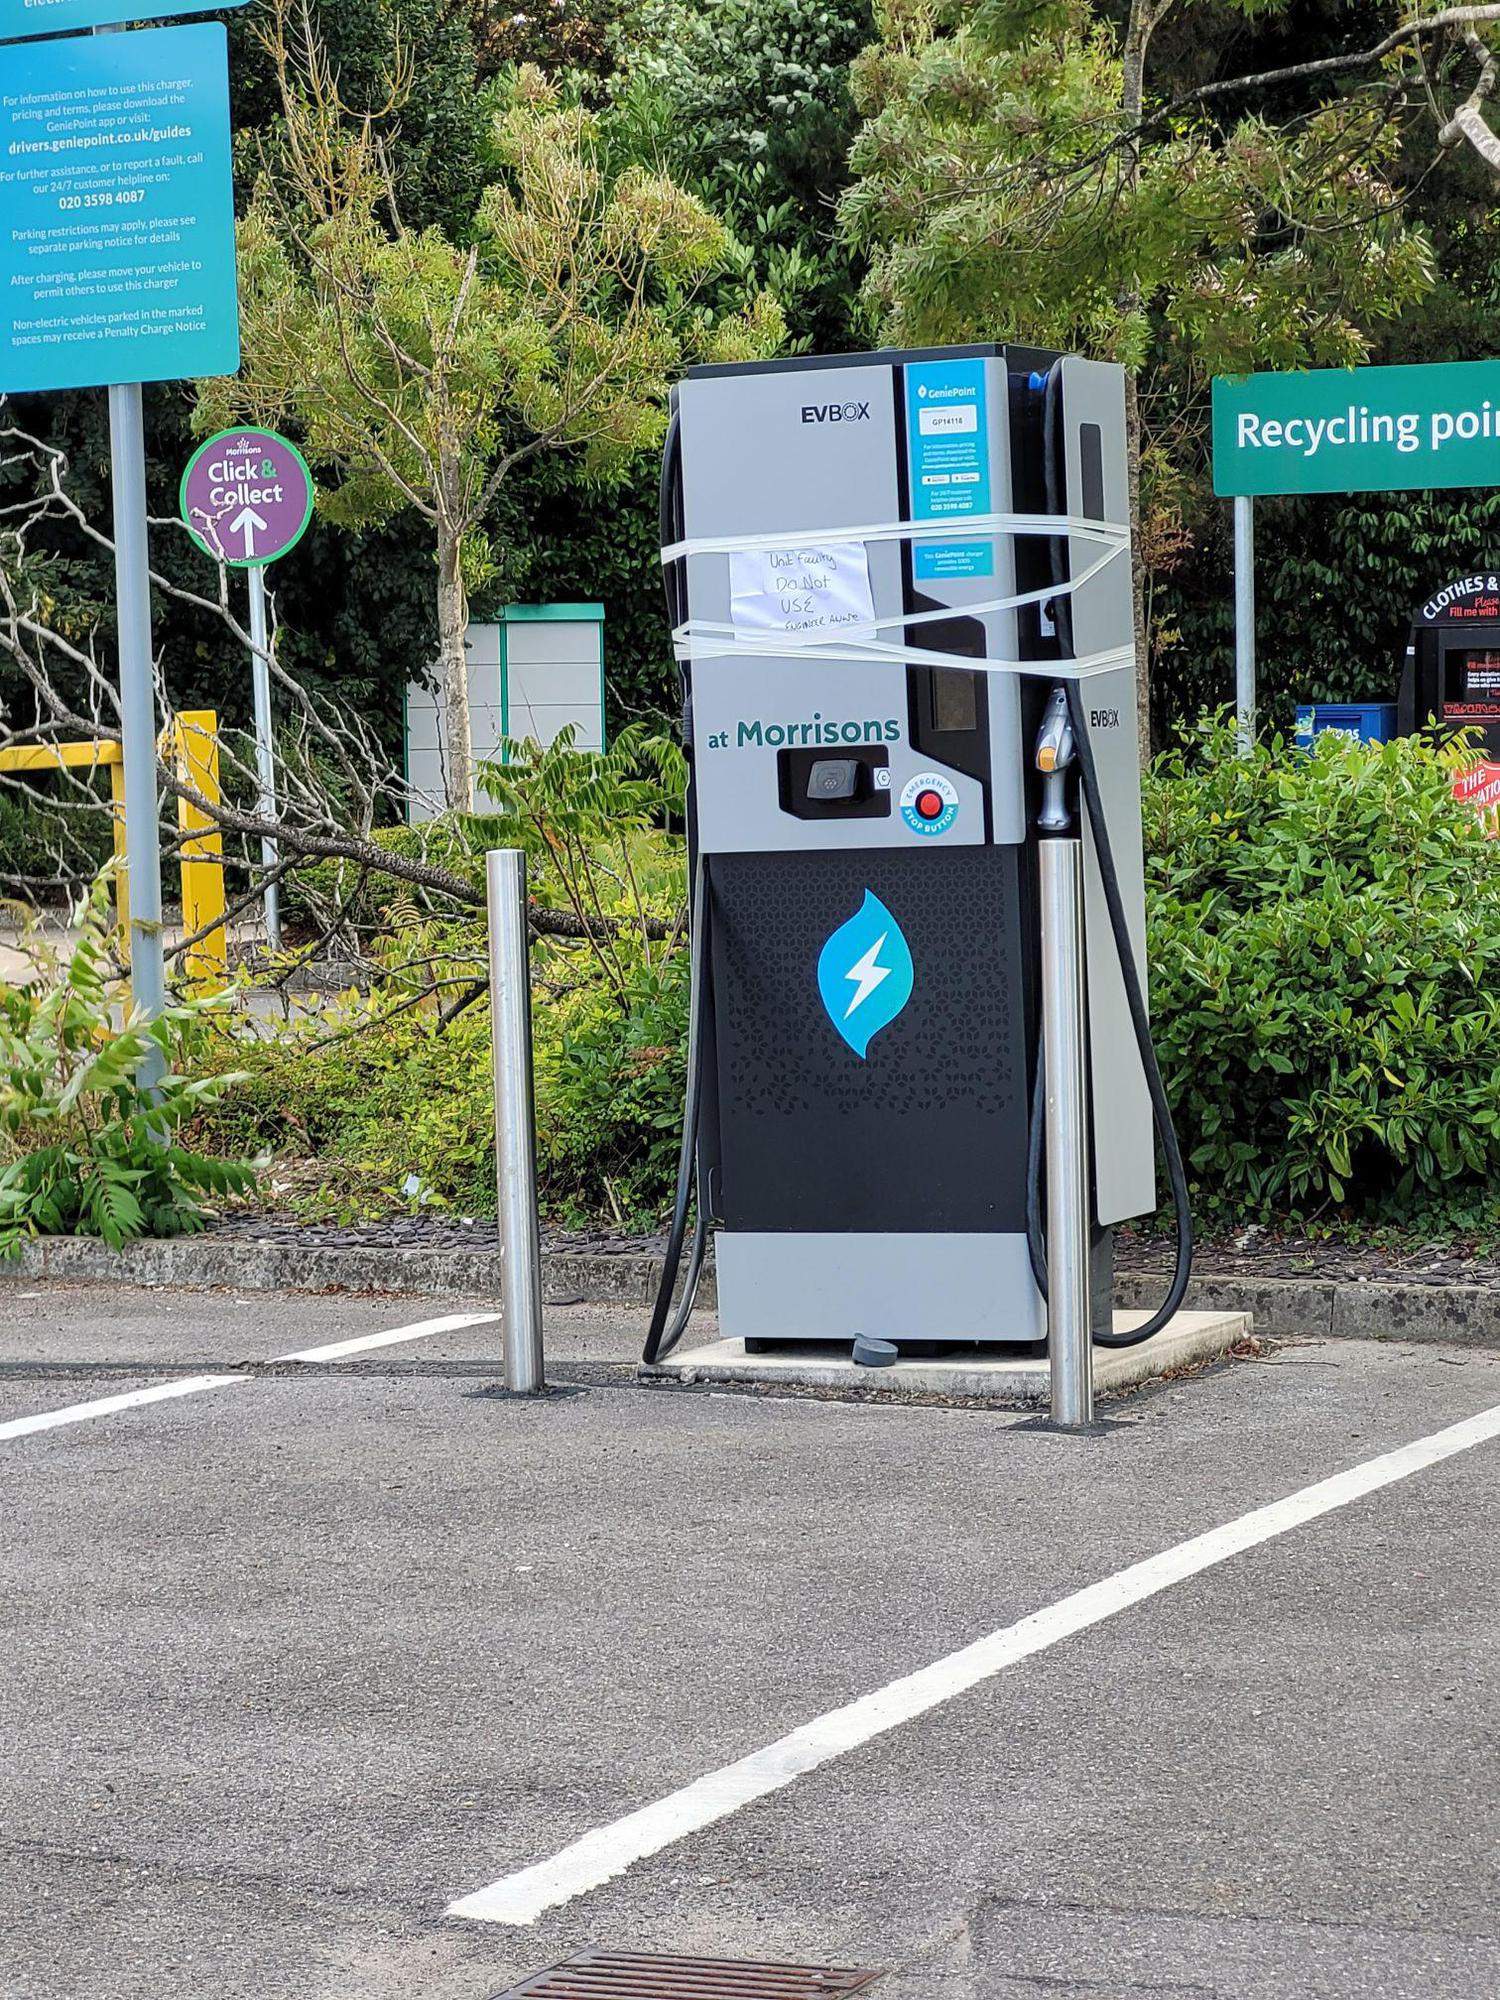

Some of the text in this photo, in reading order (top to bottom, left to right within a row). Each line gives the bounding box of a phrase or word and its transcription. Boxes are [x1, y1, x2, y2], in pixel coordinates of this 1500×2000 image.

[3, 95, 18, 107] For
[20, 91, 72, 105] information
[74, 91, 85, 99] on
[87, 88, 107, 97] how
[109, 87, 118, 95] to
[120, 85, 136, 94] use
[138, 82, 154, 92] this
[12, 111, 43, 123] pricing
[45, 107, 61, 117] and
[93, 102, 121, 114] please
[124, 98, 168, 110] download
[170, 94, 185, 104] the
[47, 119, 96, 132] GeniePoint
[99, 118, 115, 129] app
[117, 116, 126, 125] or
[9, 126, 191, 155] drivers.geniepoint.co.uk/guides
[0, 172, 15, 182] For
[17, 168, 49, 181] further
[101, 163, 111, 172] or
[112, 160, 121, 171] to
[124, 158, 153, 171] report
[155, 159, 160, 167] a
[187, 153, 203, 164] call
[33, 184, 49, 194] our
[51, 181, 72, 193] 24/7
[74, 179, 115, 190] customer
[118, 174, 154, 187] helpline
[59, 190, 145, 209] 020 3598 4087
[12, 228, 46, 241] Parking
[48, 224, 99, 237] restrictions
[101, 223, 120, 233] may
[150, 217, 178, 229] please
[180, 216, 196, 225] see
[28, 232, 180, 255] separate parking notice for details
[10, 274, 34, 285] After
[78, 270, 106, 282] please
[108, 267, 133, 277] move
[135, 264, 155, 276] your
[157, 261, 189, 272] vehicle
[192, 261, 201, 270] to
[34, 279, 179, 300] permit others to use this charger
[13, 305, 203, 330] Non-electric vehicles parked in the marked
[12, 321, 206, 347] spaces may receive a Penalty Charge Notice
[928, 385, 976, 398] GeniePoint
[1238, 406, 1420, 456] Recycling
[226, 446, 261, 456] Morrisons
[208, 458, 277, 482] Click &
[210, 483, 283, 507] Collect
[770, 553, 794, 568] Unit
[780, 596, 814, 614] USE
[1423, 576, 1499, 620] CLOTHES &
[1449, 606, 1498, 617] Fill me with
[708, 712, 900, 748] at Morrisons
[906, 777, 952, 799] EMERGENCY
[1461, 769, 1486, 795] THE
[904, 807, 955, 832] STOP BUTTON
